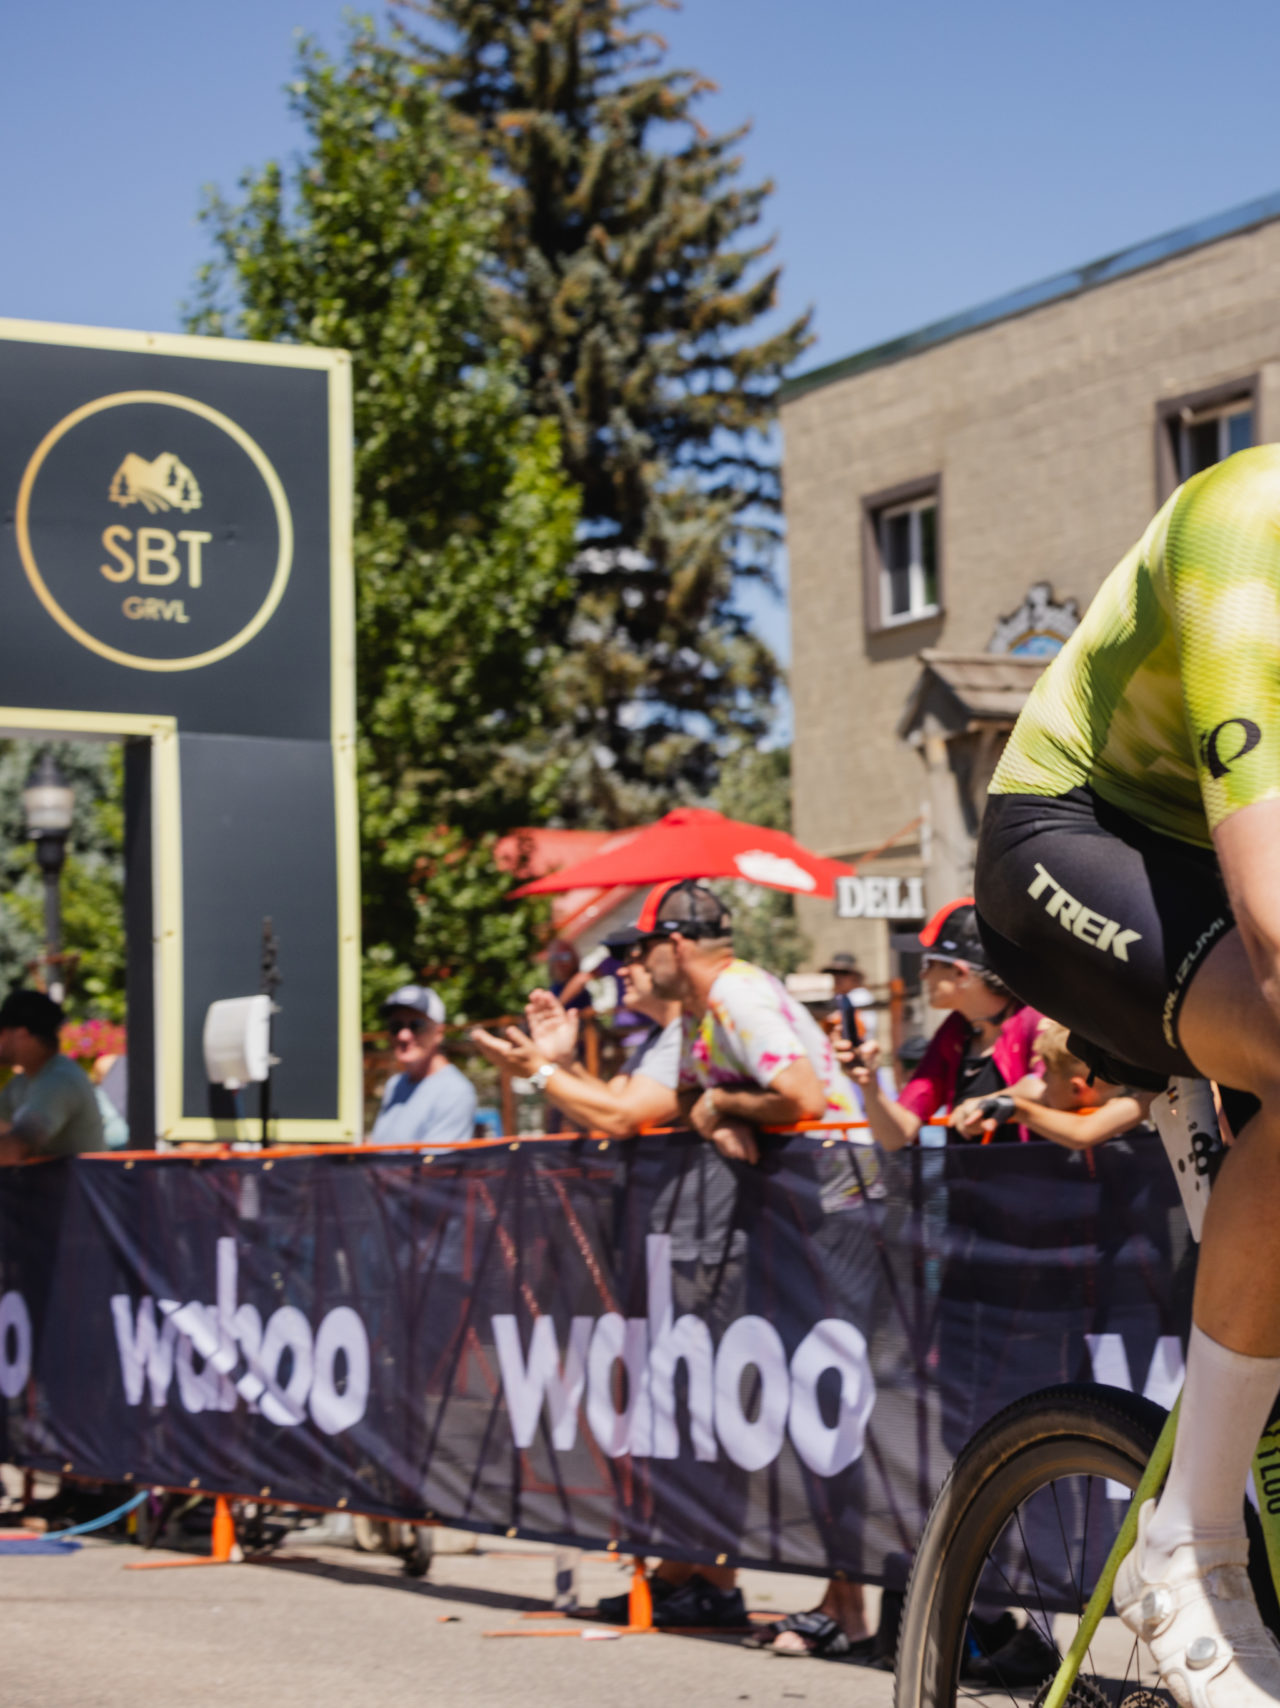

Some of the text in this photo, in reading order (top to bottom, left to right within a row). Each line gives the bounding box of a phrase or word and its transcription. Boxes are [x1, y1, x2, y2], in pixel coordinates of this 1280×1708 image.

[101, 524, 212, 588] SBT
[122, 595, 189, 623] GRVL
[838, 877, 925, 918] DELI
[1027, 862, 1142, 962] TREK
[111, 1237, 370, 1435] wahoo
[492, 1234, 875, 1477] wahoo
